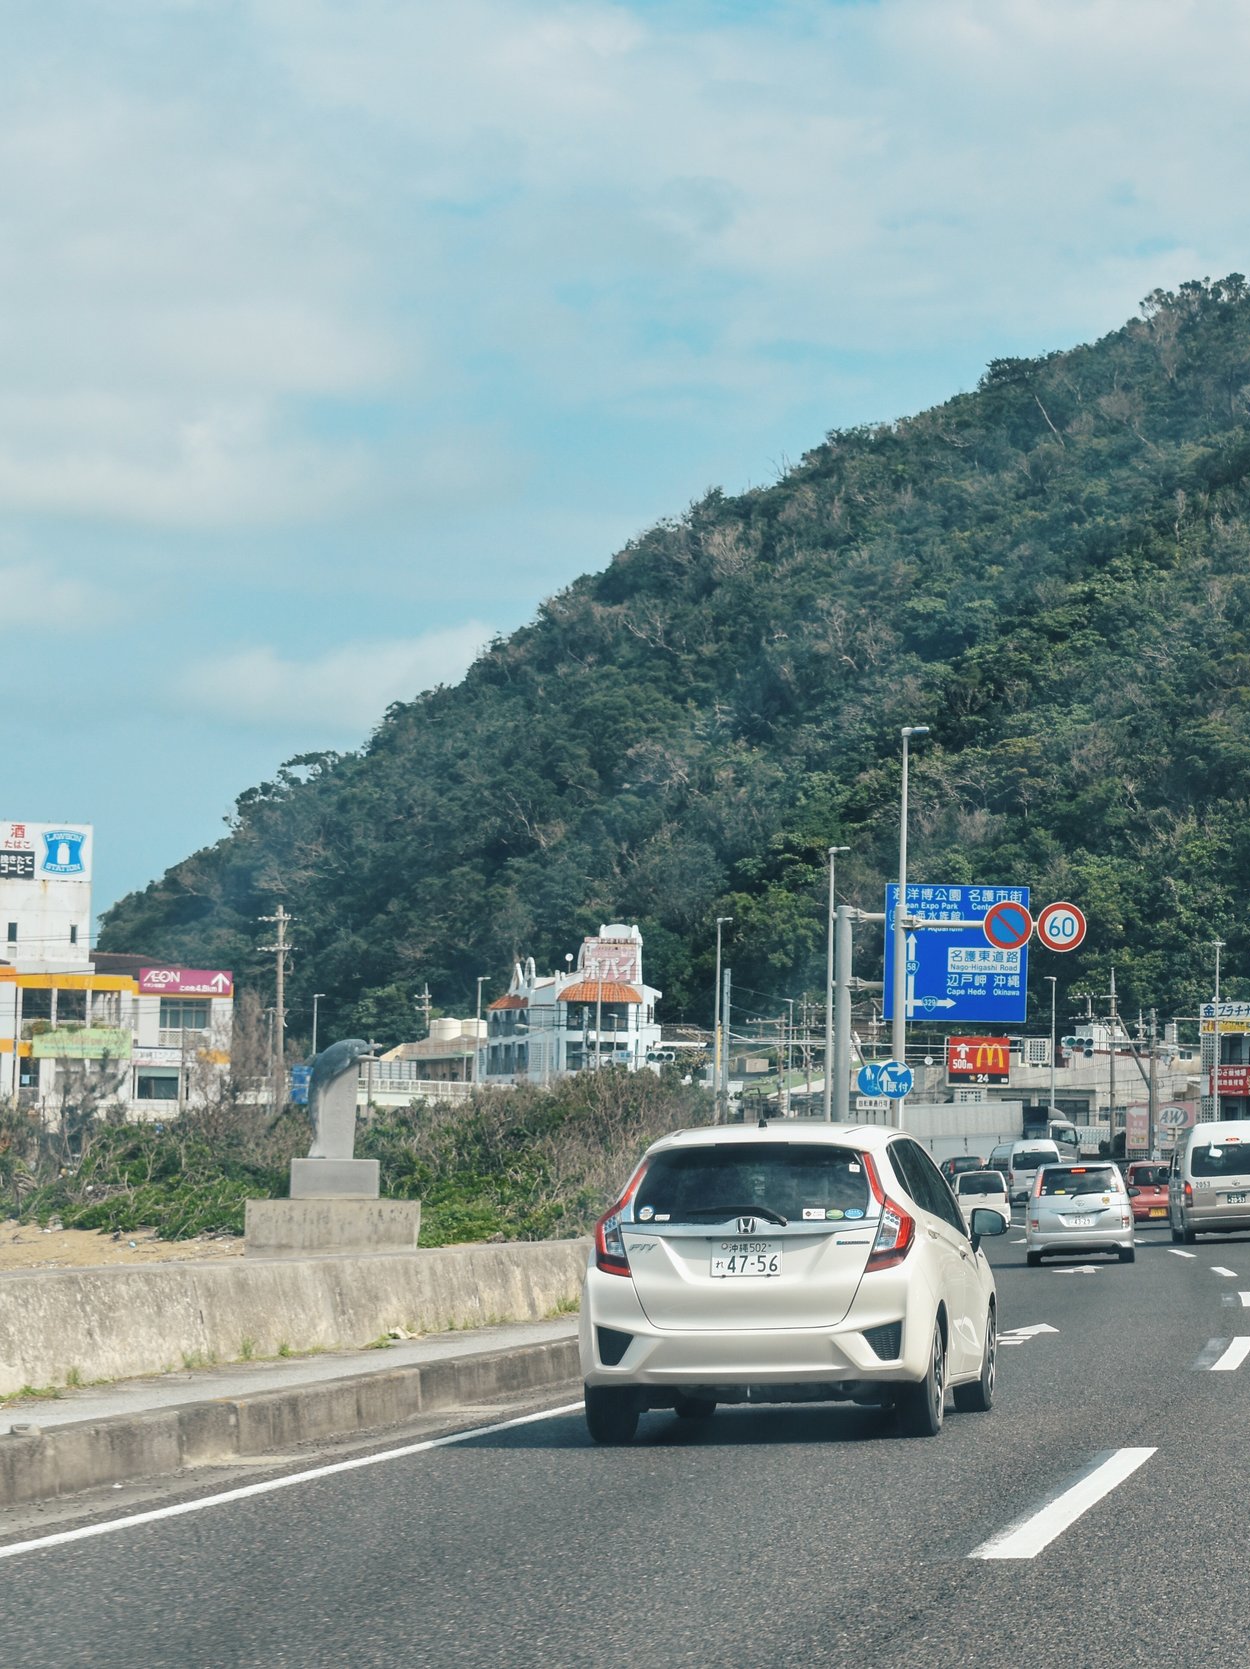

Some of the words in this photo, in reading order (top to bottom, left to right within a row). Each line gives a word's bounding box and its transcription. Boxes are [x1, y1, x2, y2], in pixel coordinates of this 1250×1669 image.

[11, 824, 26, 838] 酒
[4, 840, 31, 849] たばこ
[0, 864, 34, 874] コーヒー
[921, 902, 940, 911] Expo
[941, 902, 959, 910] Park
[1049, 916, 1075, 937] 60
[950, 949, 1019, 963] 名護東道路
[906, 962, 917, 972] 58
[950, 963, 998, 973] Nago-Higashi
[999, 963, 1018, 972] Road
[946, 974, 987, 987] 辺戸岬
[993, 974, 1020, 988] 沖縄
[946, 987, 966, 996] Cape
[967, 988, 987, 996] Hedo
[992, 988, 1020, 996] Okinawa
[923, 998, 936, 1007] 329
[1203, 1004, 1215, 1018] 金
[952, 1058, 974, 1070] 500m
[977, 1073, 989, 1083] 24
[887, 1081, 909, 1093] 原付
[1195, 1181, 1211, 1189] 2053
[727, 1255, 778, 1273] 47-56
